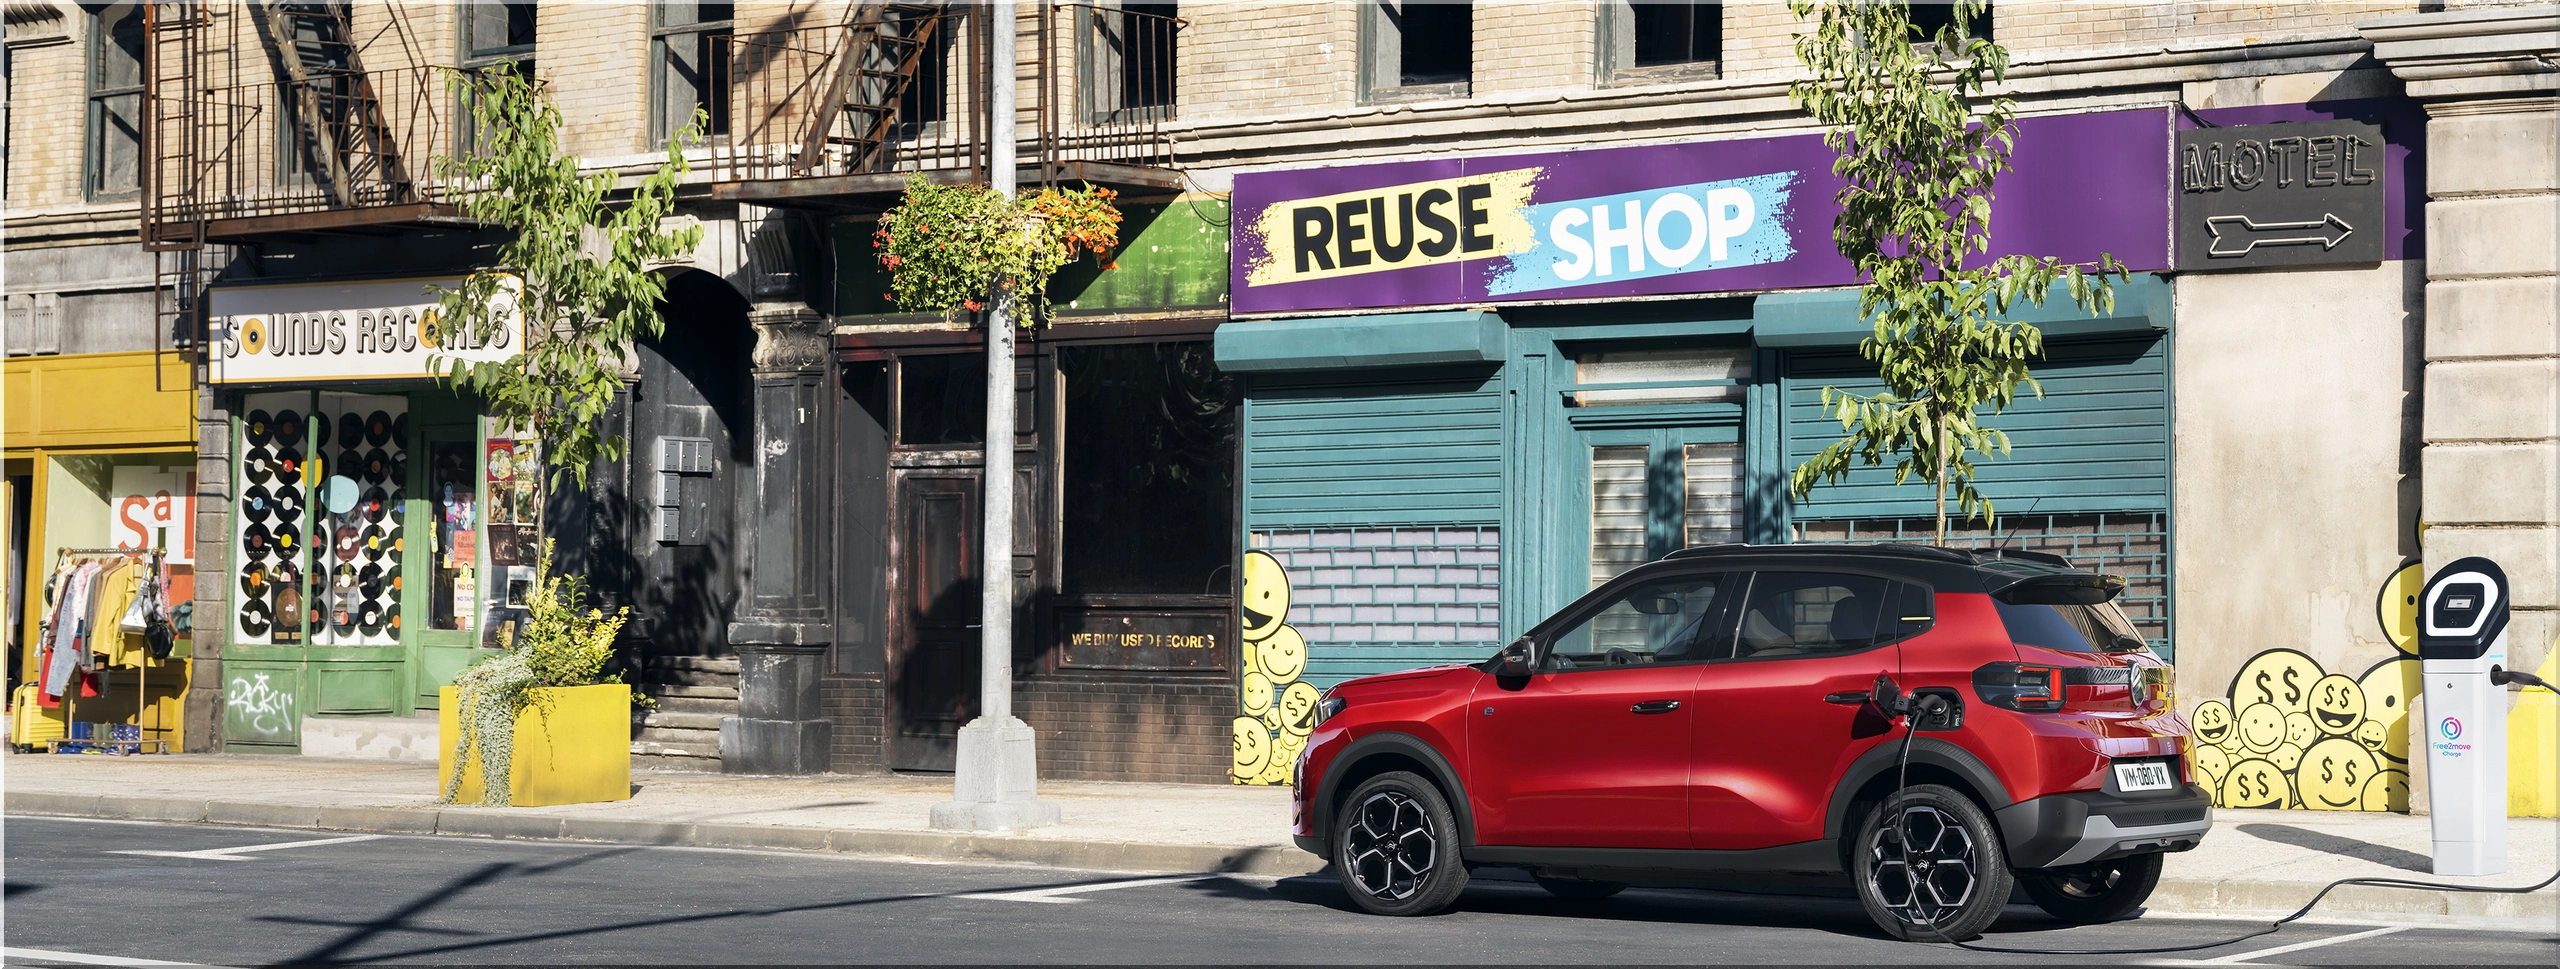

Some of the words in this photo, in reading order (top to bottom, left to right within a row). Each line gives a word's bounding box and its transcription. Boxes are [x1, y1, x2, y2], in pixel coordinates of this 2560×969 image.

[2183, 135, 2376, 193] MOTEL
[1292, 182, 1494, 274] REUSE
[1549, 186, 1756, 282] SHOP
[222, 310, 347, 359] SOUNDS
[1071, 633, 1092, 646] WE
[1093, 633, 1119, 647] BUY
[2432, 741, 2472, 751] Free2move
